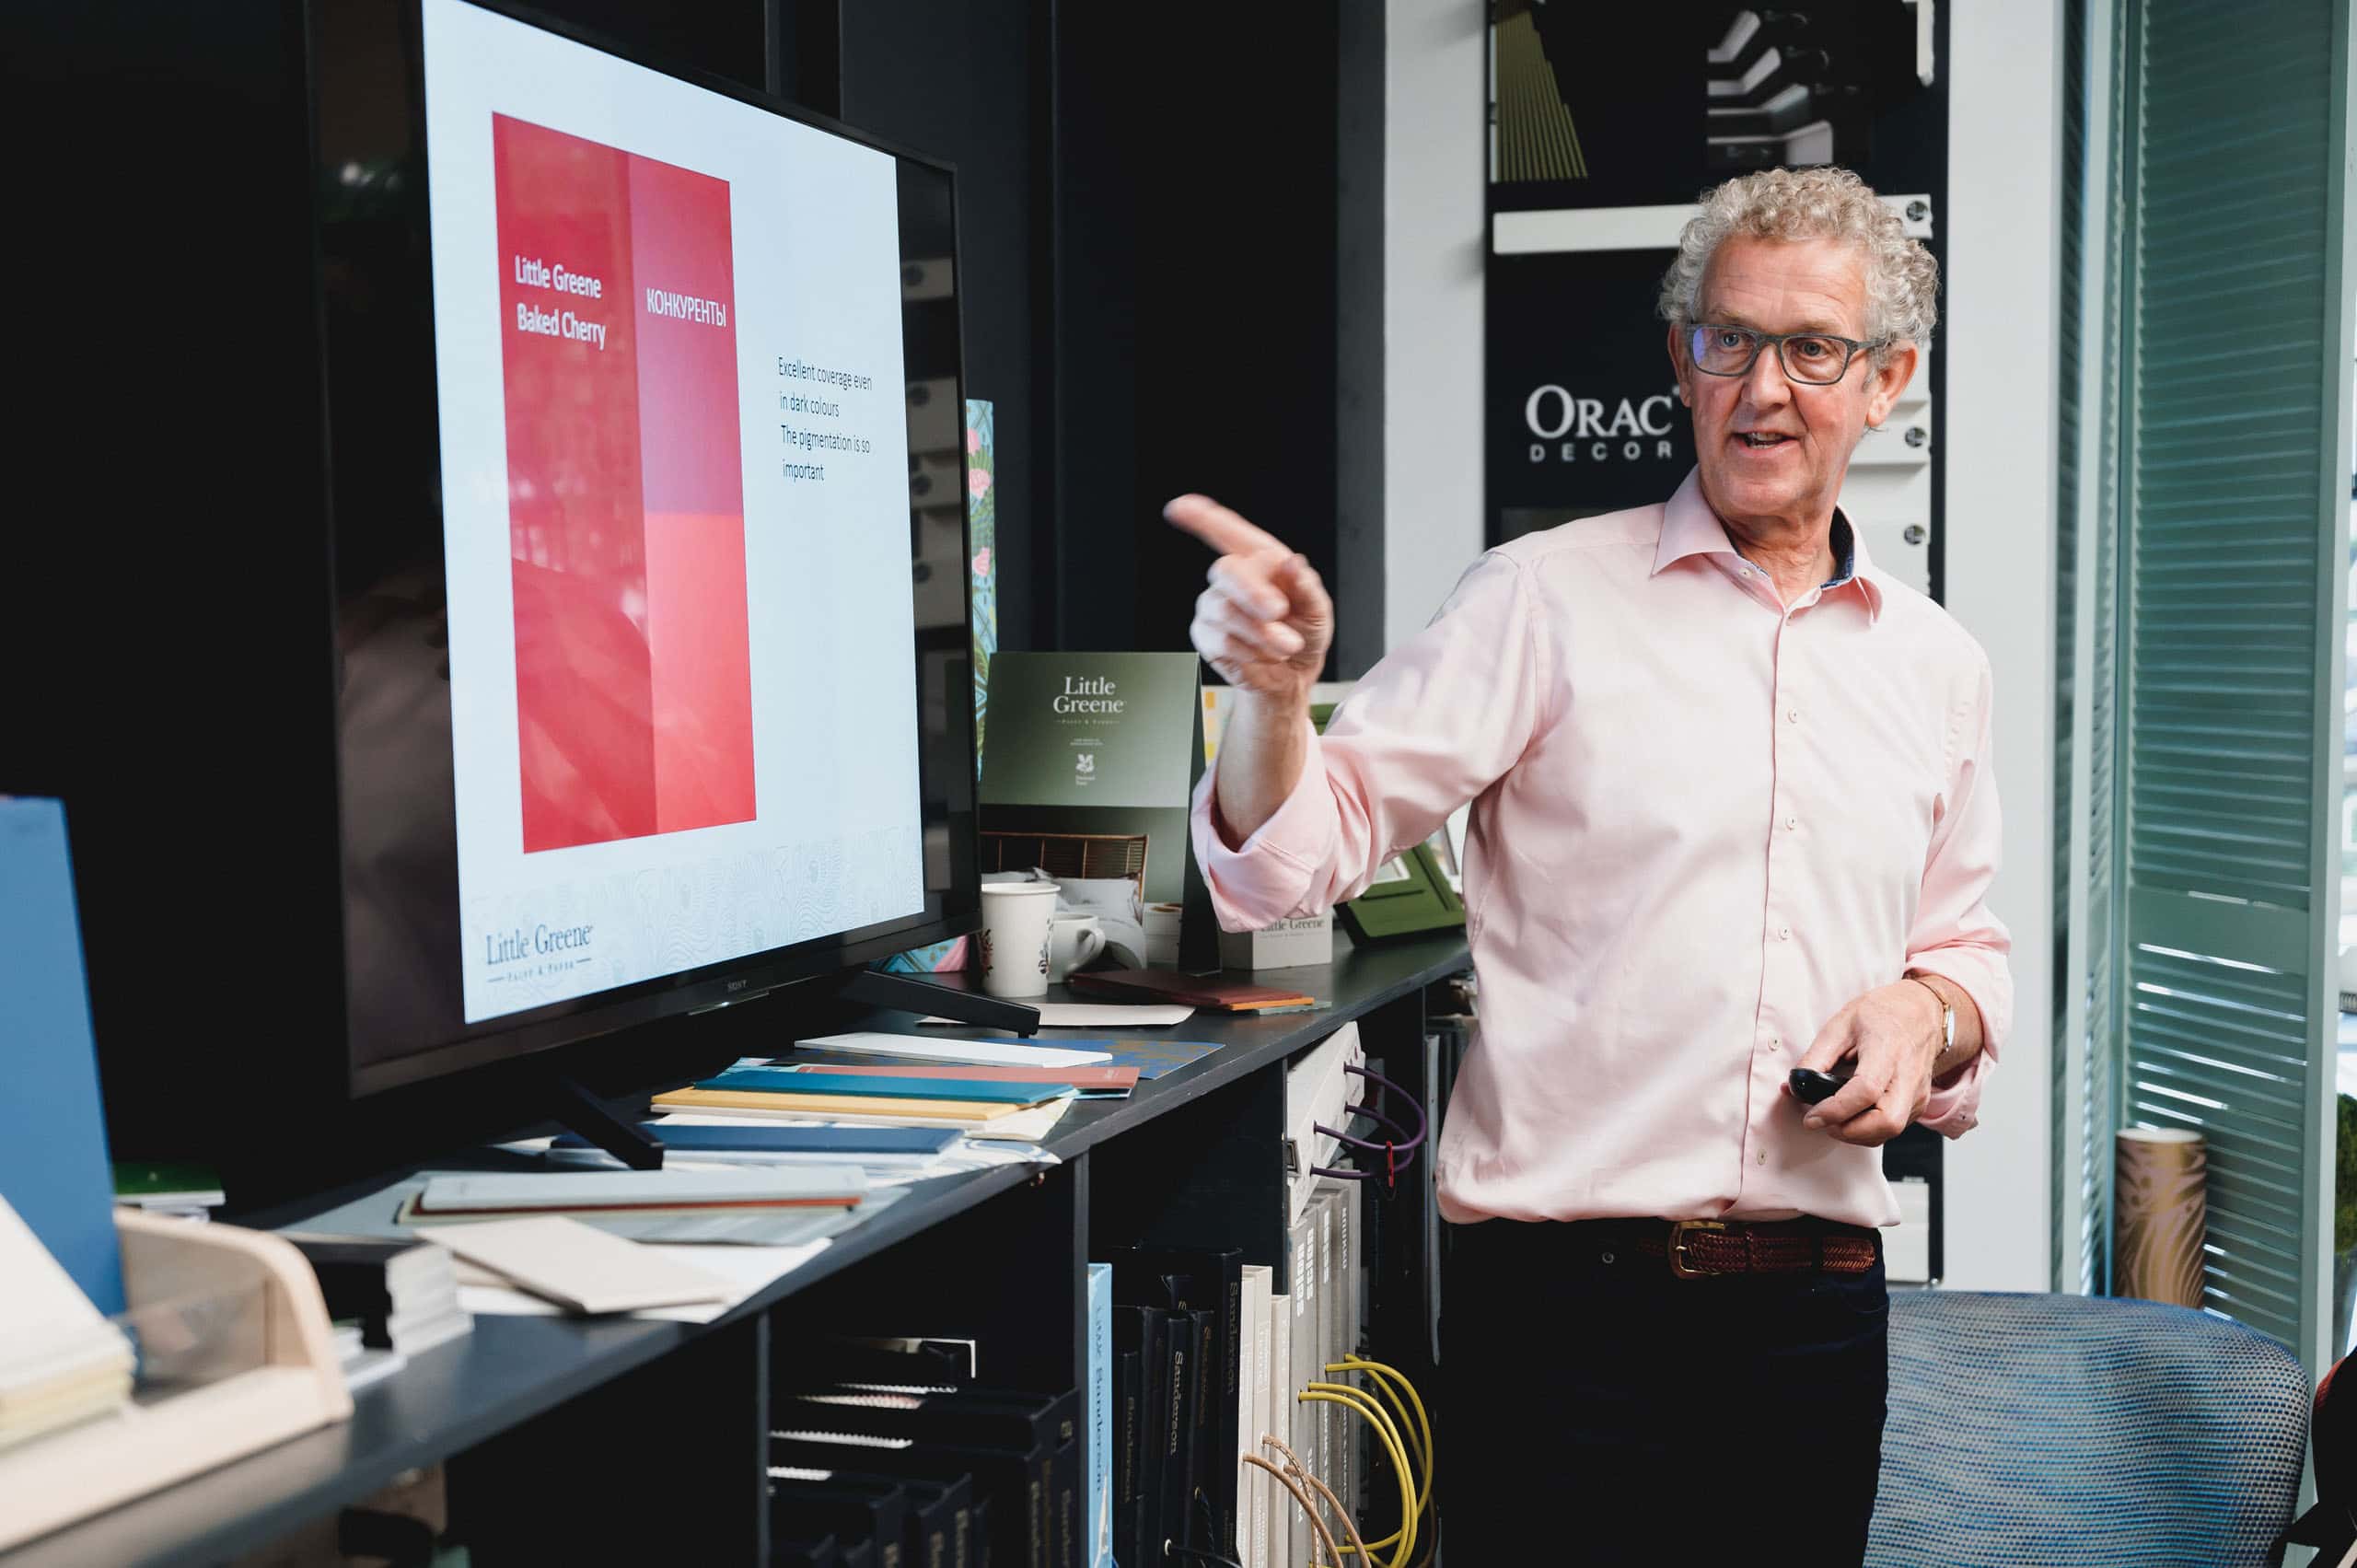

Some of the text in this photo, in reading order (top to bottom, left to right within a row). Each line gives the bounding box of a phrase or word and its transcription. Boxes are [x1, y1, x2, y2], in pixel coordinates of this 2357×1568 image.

[515, 254, 602, 299] Little Greene
[646, 286, 726, 328] КОНКУРЕНТЫ
[517, 302, 606, 352] Baked Cherry
[778, 356, 873, 391] Excellent coverage even
[780, 390, 840, 417] in dark colours
[1526, 384, 1674, 439] ORAC
[781, 424, 871, 454] The pigmentation is so
[1530, 441, 1672, 463] DECOR
[783, 459, 825, 482] important
[1064, 676, 1117, 695] Little
[1052, 695, 1124, 714] Greene
[1289, 919, 1323, 930] Greene
[485, 923, 592, 965] Little Greene
[1226, 1282, 1239, 1395] Sanderson
[1170, 1350, 1183, 1456] Sanderson
